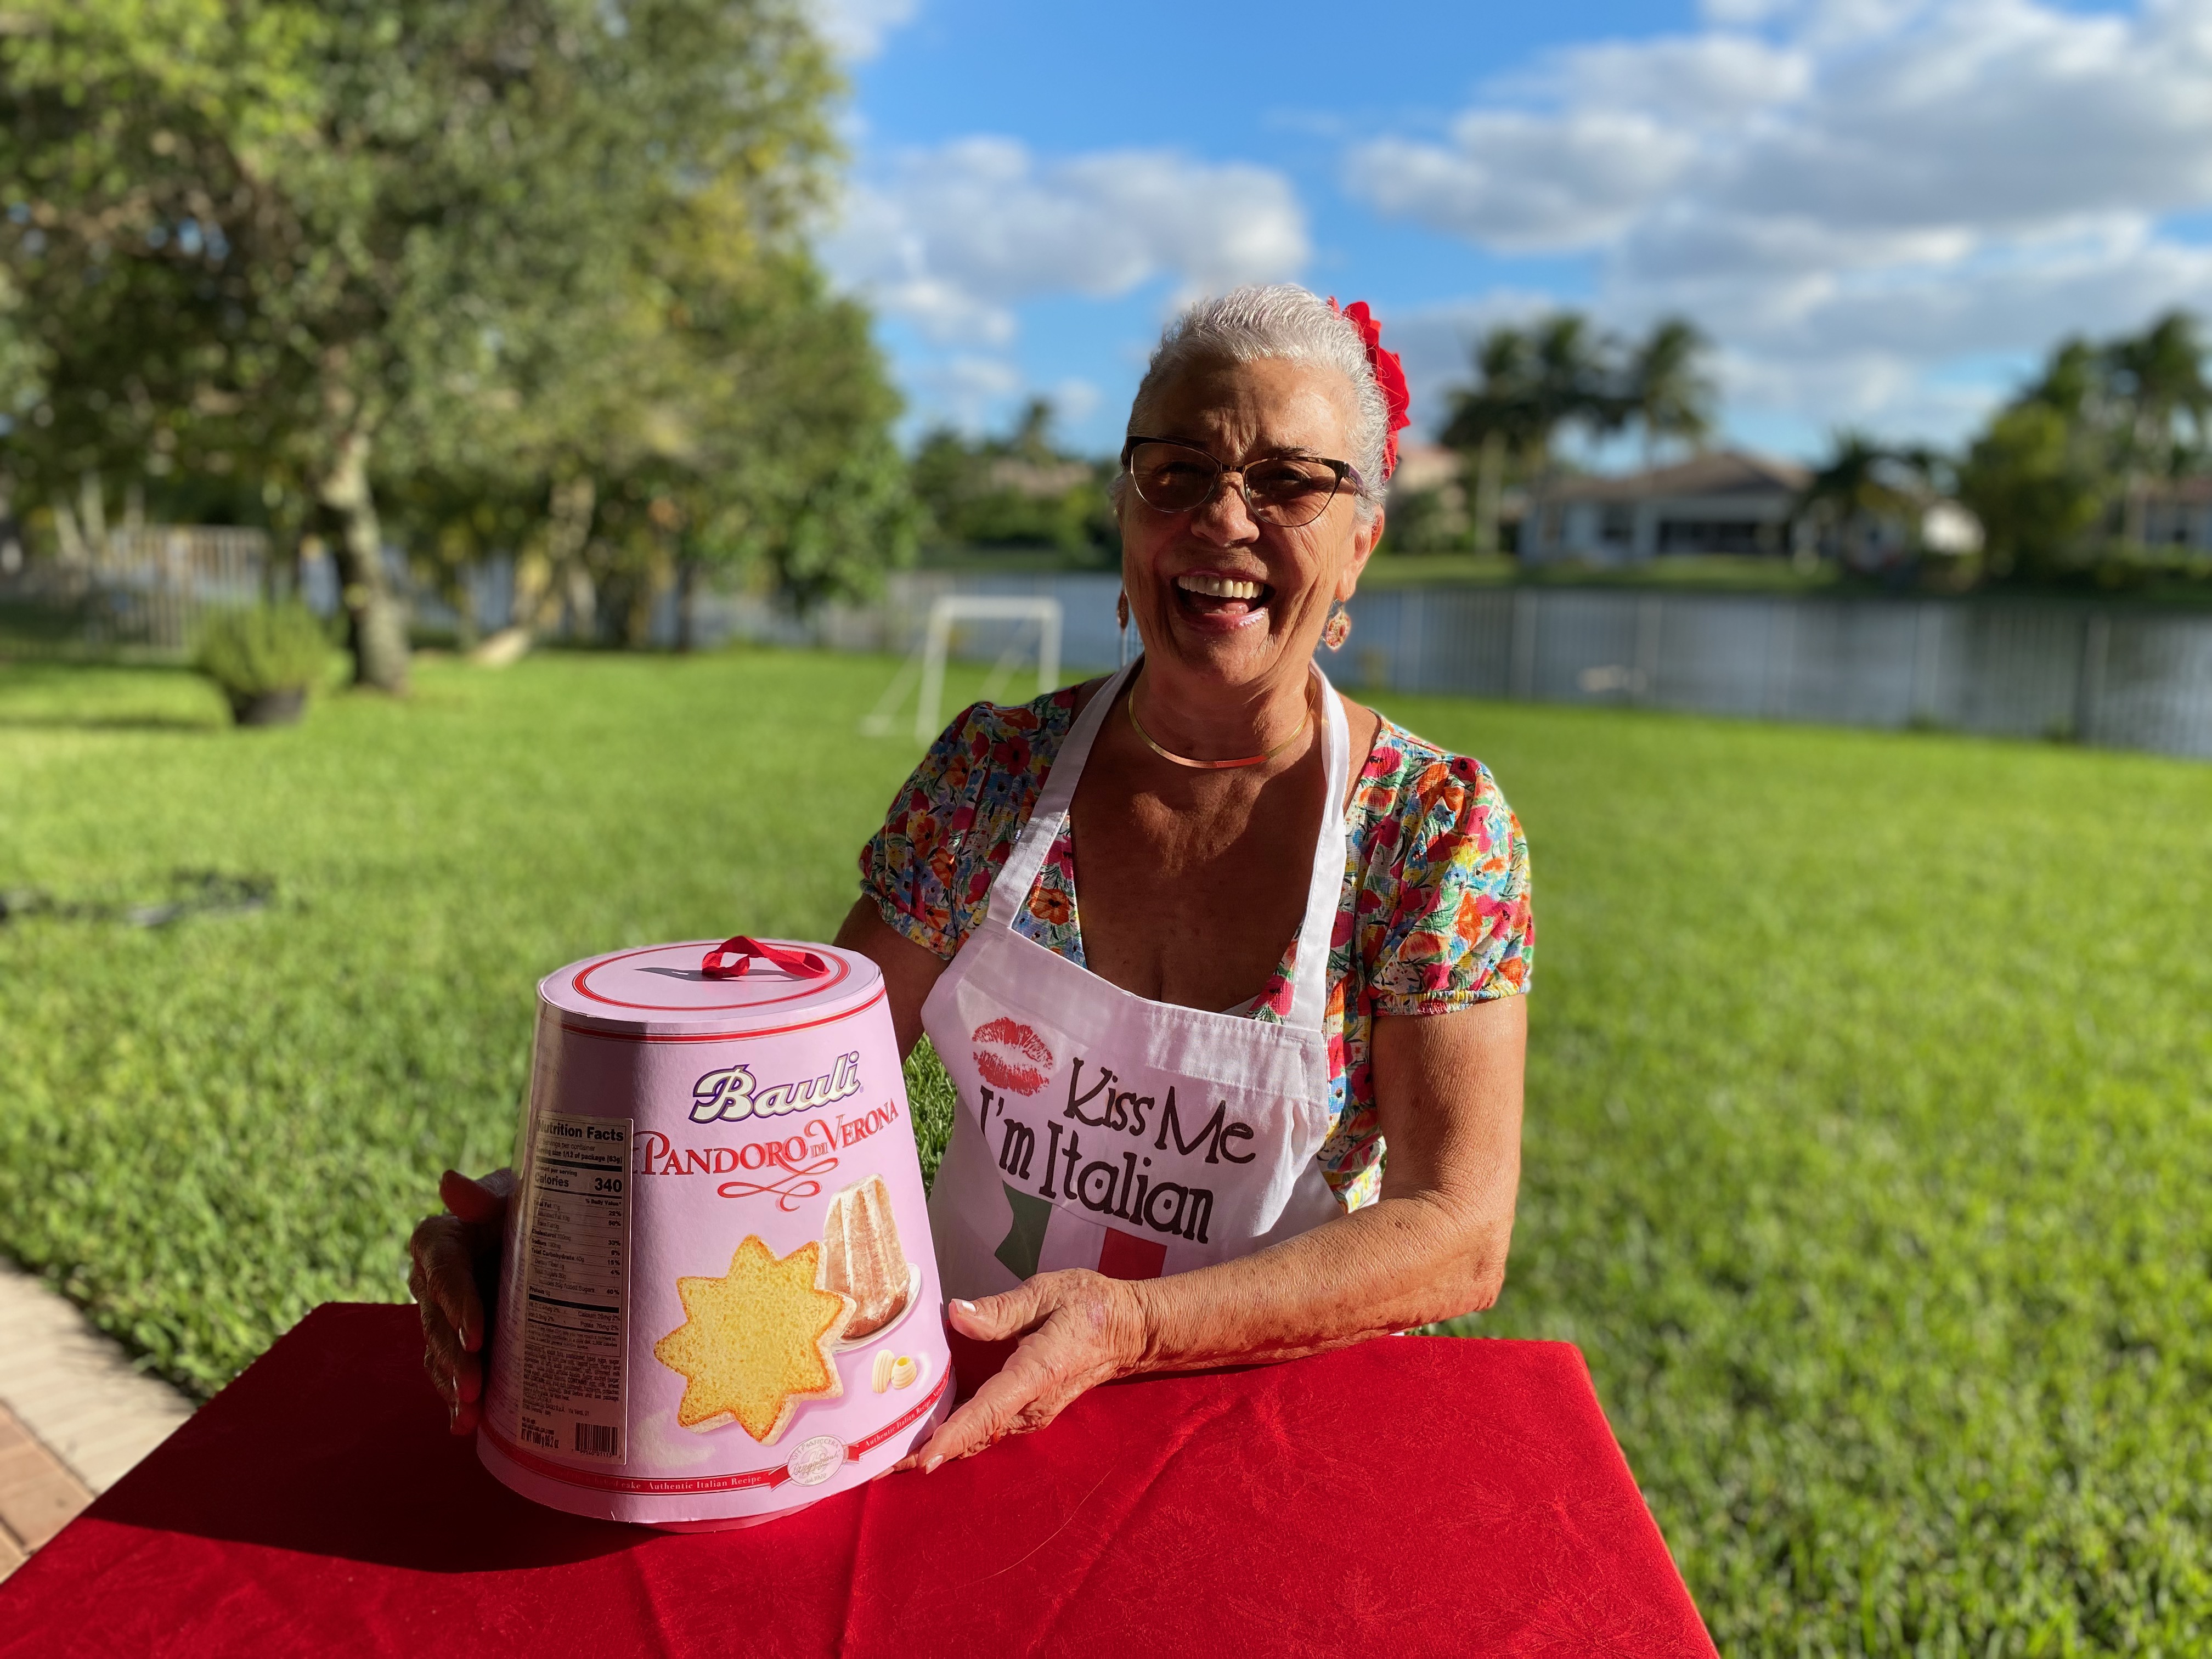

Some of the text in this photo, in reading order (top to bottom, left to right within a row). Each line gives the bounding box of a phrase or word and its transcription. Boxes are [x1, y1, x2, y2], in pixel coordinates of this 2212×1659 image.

[688, 1050, 860, 1124] Bauli
[1063, 1057, 1256, 1164] Kiss Me
[538, 1119, 624, 1142] Nutrition Facts
[633, 1130, 808, 1176] PANDORO
[804, 1098, 899, 1152] VERONA
[561, 1142, 570, 1150] per
[571, 1143, 596, 1152] container
[581, 1154, 605, 1163] package
[980, 1084, 1214, 1244] I'm Italian
[535, 1171, 622, 1193] Calories 340
[559, 1169, 578, 1177] serving
[542, 1250, 574, 1261] Carbohydrate
[529, 1286, 544, 1295] Protein
[865, 1399, 932, 1447] Authentic Italian Recipe
[648, 1475, 762, 1490] Authentic Italian Recipe
